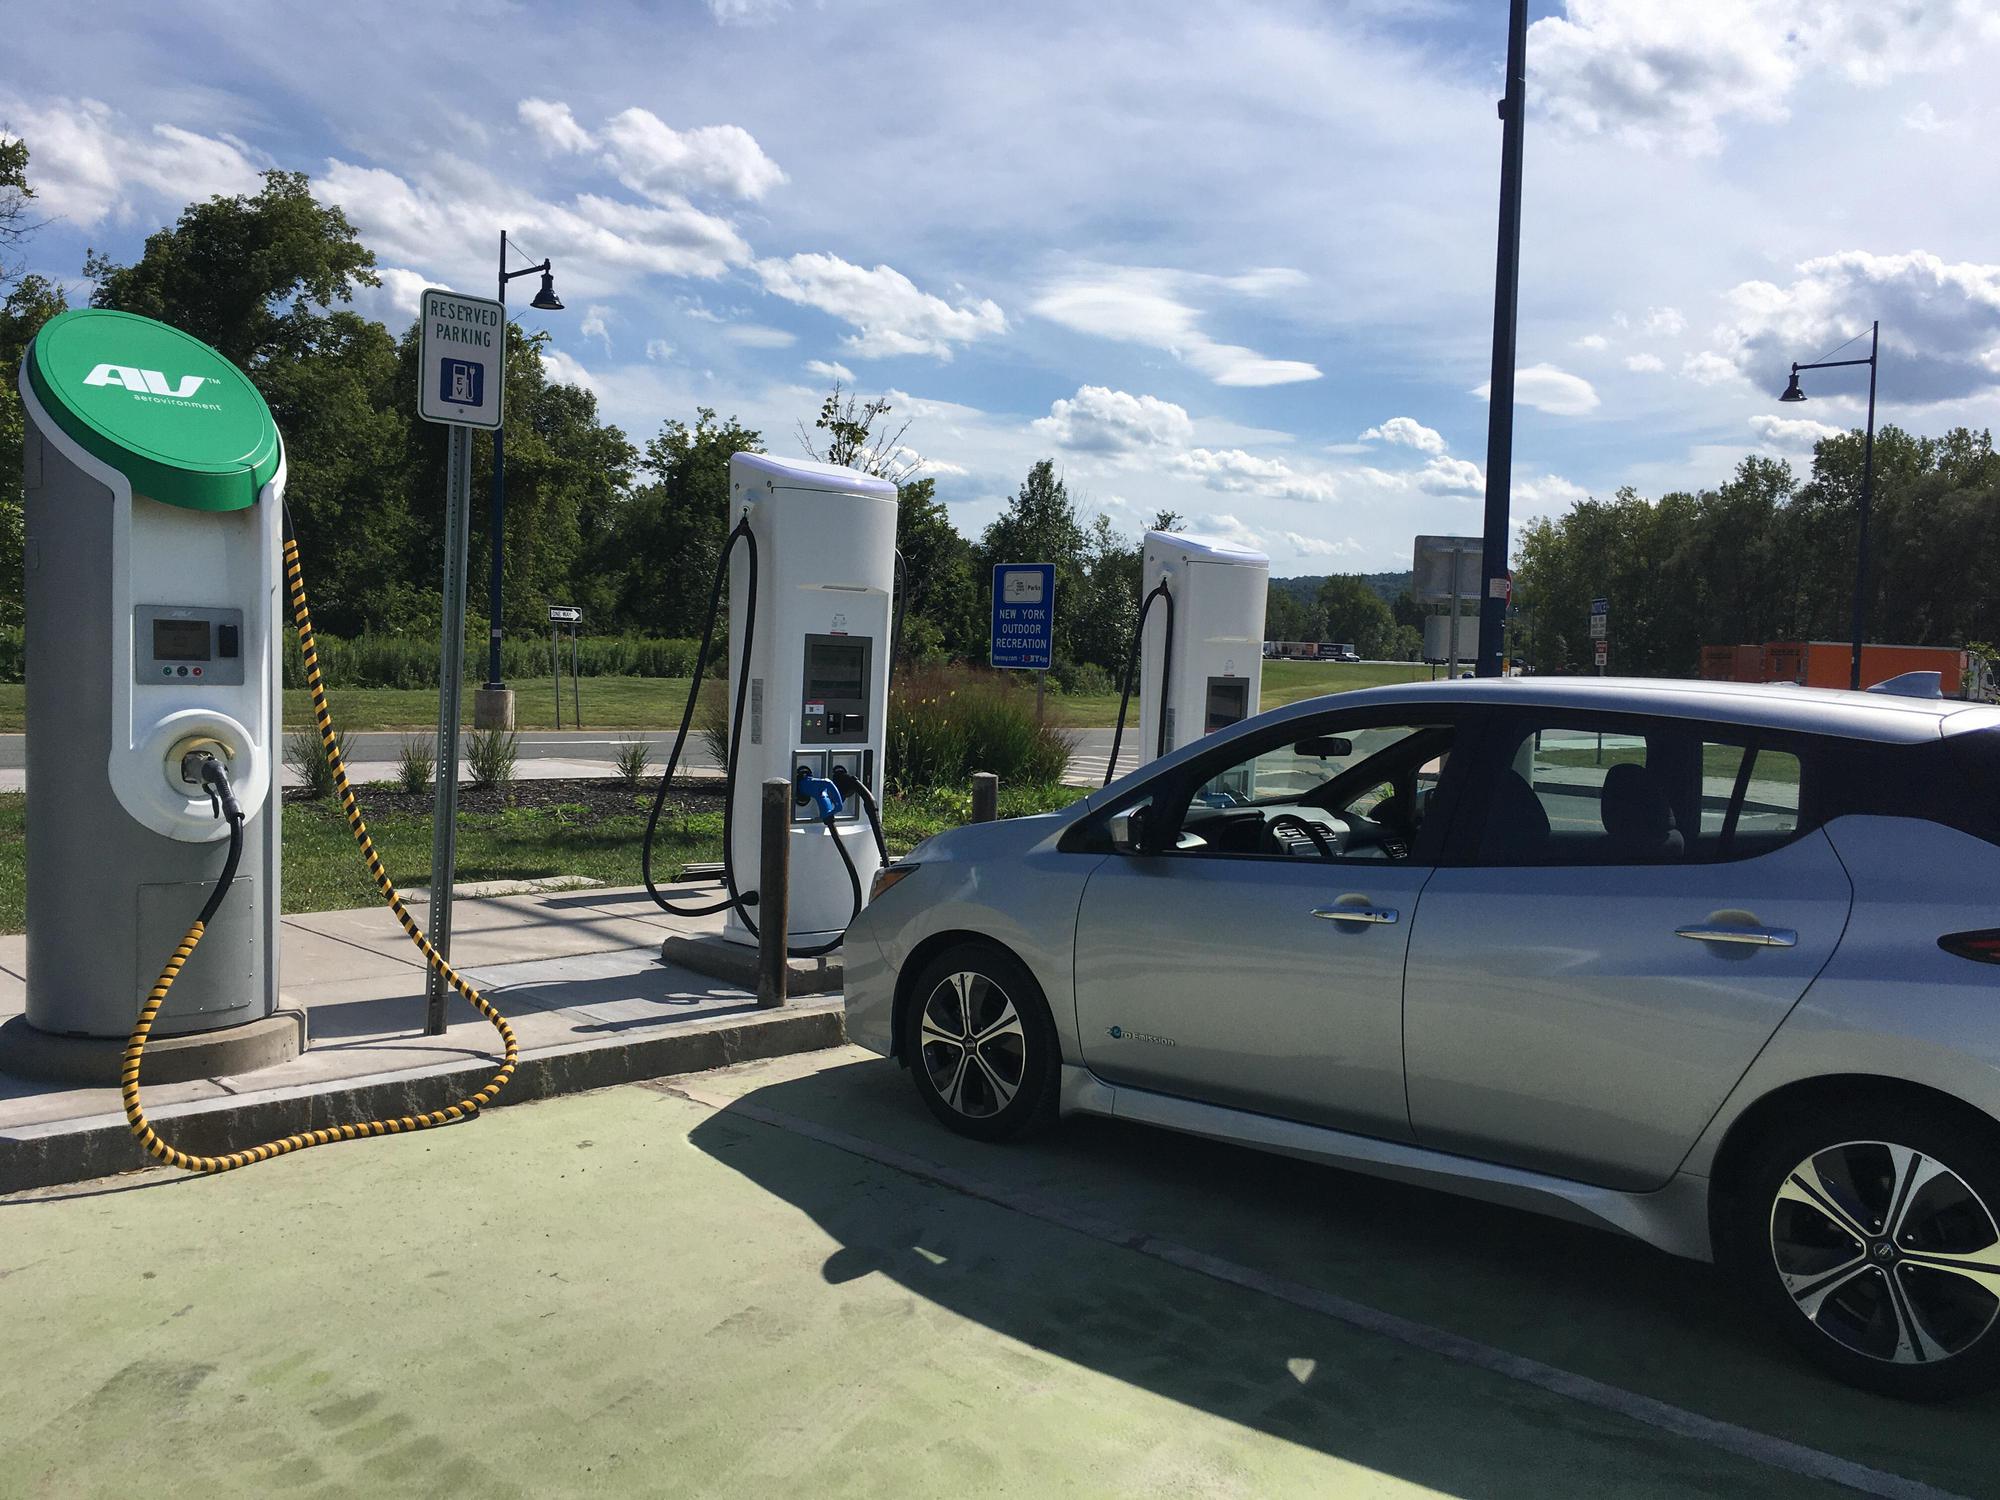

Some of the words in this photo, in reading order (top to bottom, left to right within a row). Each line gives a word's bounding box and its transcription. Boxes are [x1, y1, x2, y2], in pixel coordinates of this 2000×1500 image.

[430, 300, 497, 326] RESERVED
[436, 323, 491, 347] PARKING
[133, 394, 222, 411] aerovironment
[999, 609, 1017, 620] NEW
[1022, 609, 1045, 620] YORK
[1002, 623, 1041, 634] OUTDOOR
[996, 638, 1047, 649] RECREATION
